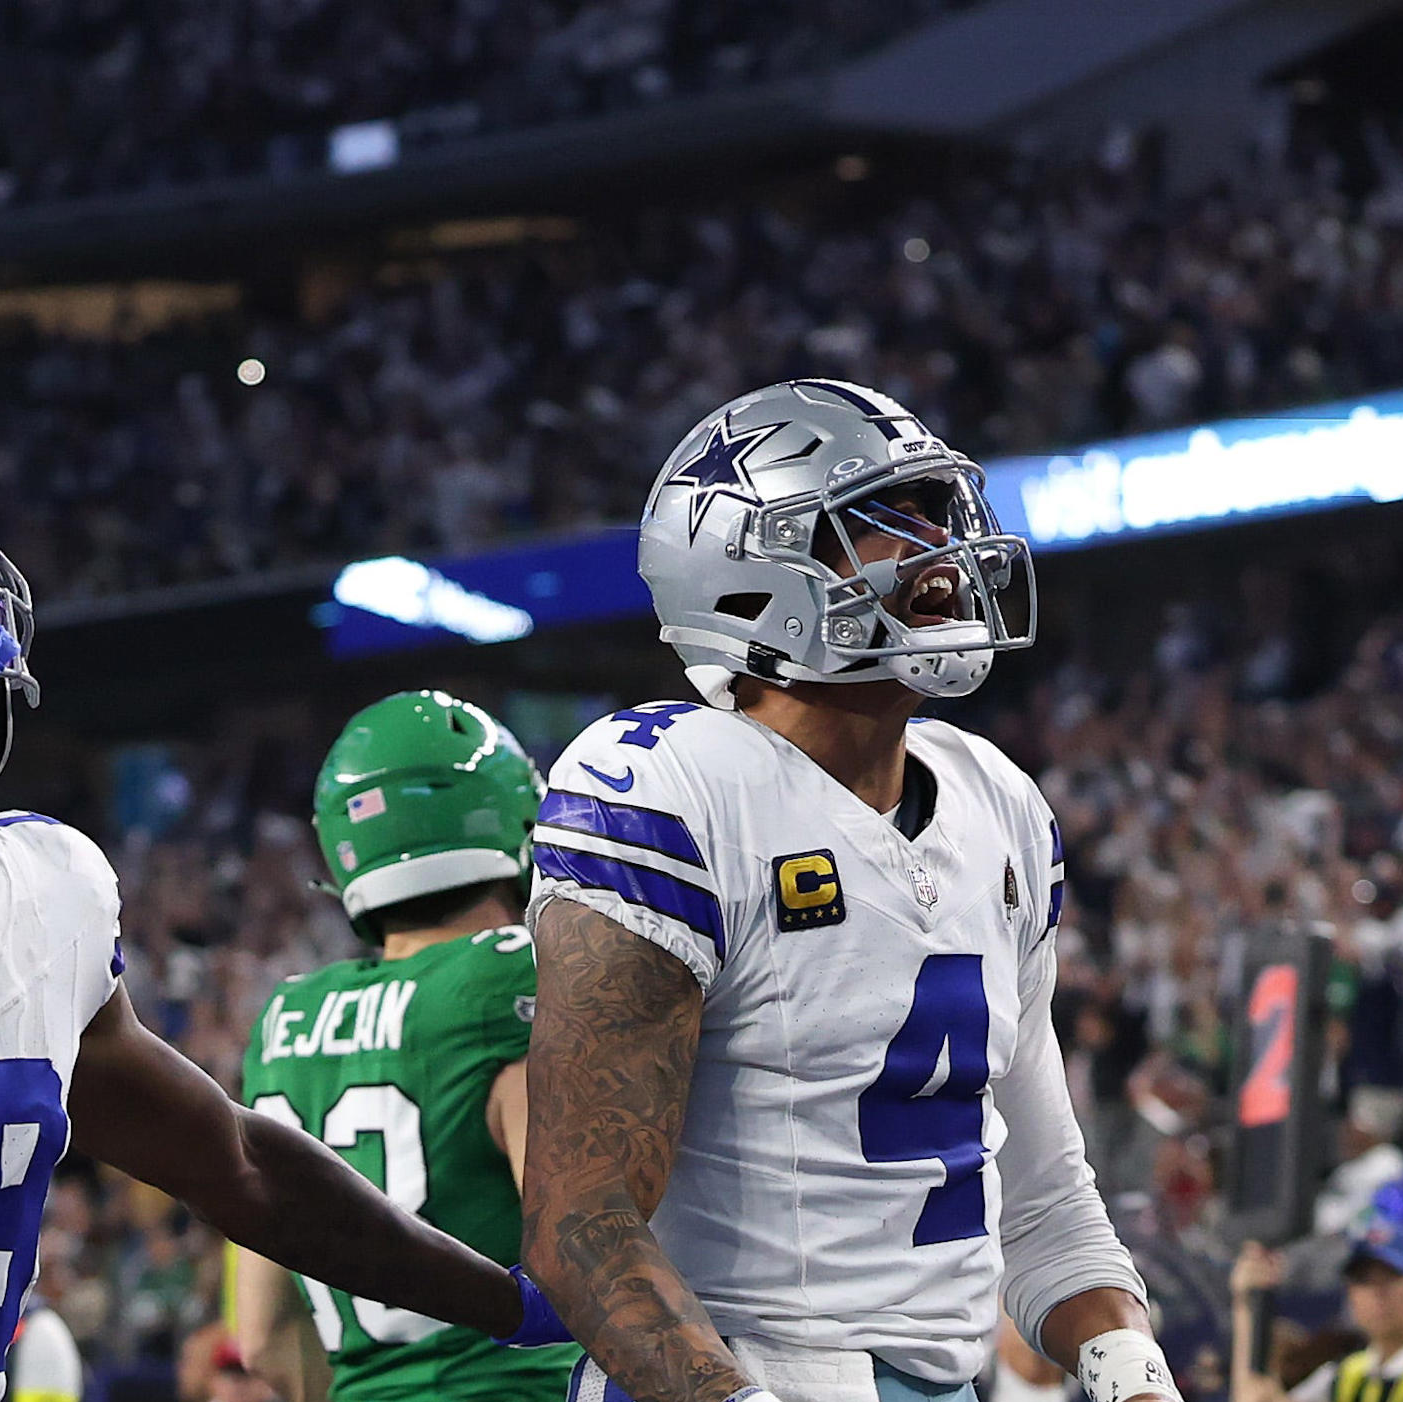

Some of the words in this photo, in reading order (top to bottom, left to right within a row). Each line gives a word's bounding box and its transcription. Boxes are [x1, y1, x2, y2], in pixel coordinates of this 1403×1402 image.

[777, 853, 839, 910] C
[856, 952, 995, 1249] 4
[1238, 963, 1297, 1129] 2
